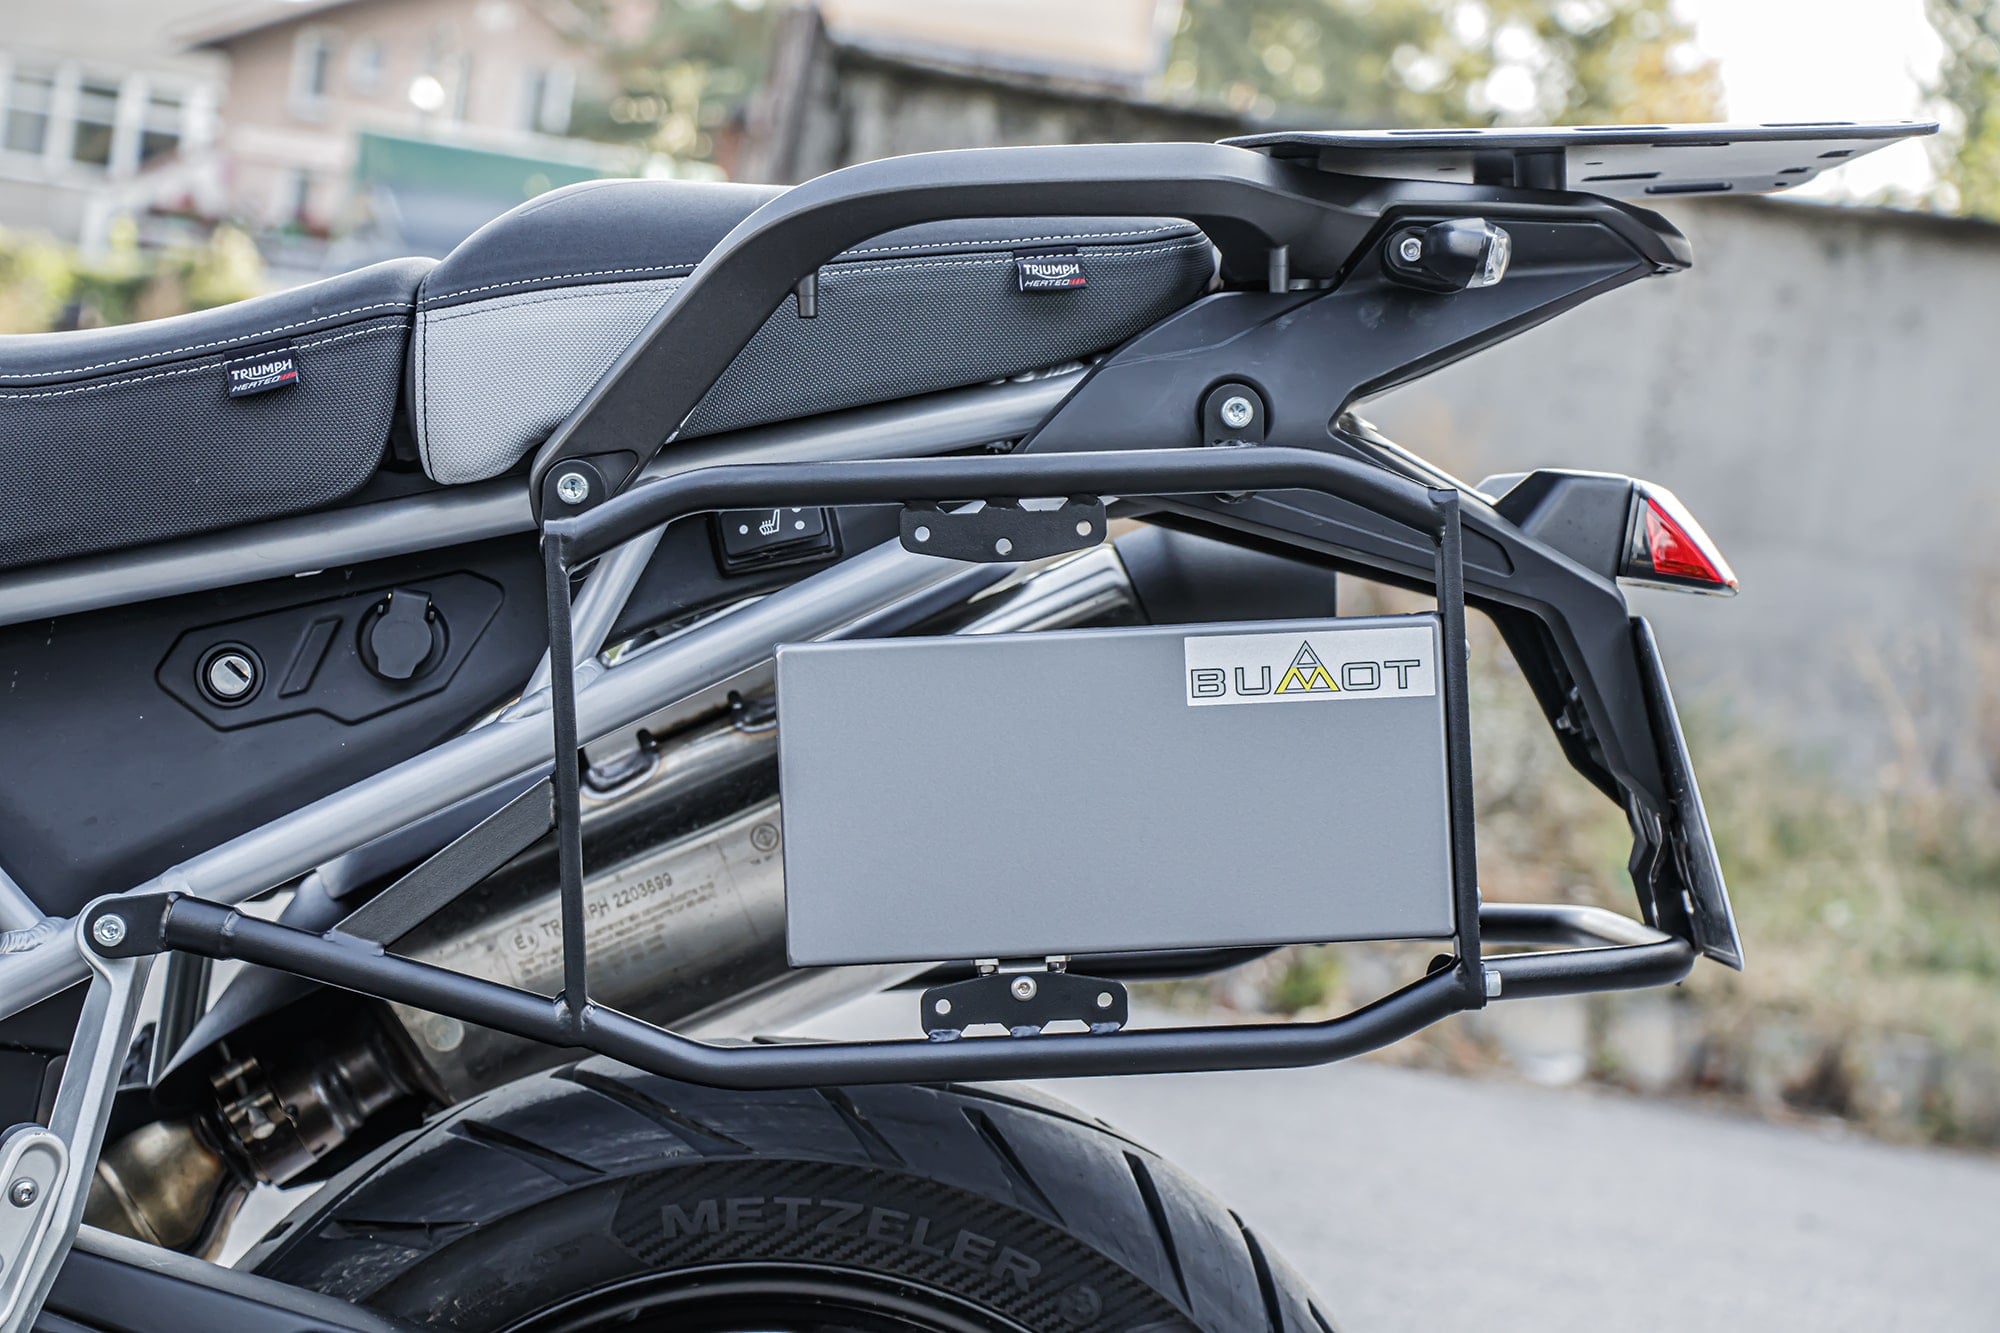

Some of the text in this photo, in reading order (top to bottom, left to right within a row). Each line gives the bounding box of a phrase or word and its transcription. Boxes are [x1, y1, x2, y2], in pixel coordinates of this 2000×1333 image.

[1023, 263, 1079, 279] TRIUMPH
[1024, 279, 1070, 287] HEATED
[231, 358, 292, 380] TRIUMPH
[232, 375, 280, 392] HEATED
[540, 898, 610, 936] TRPH
[662, 1196, 1042, 1293] METZELER
